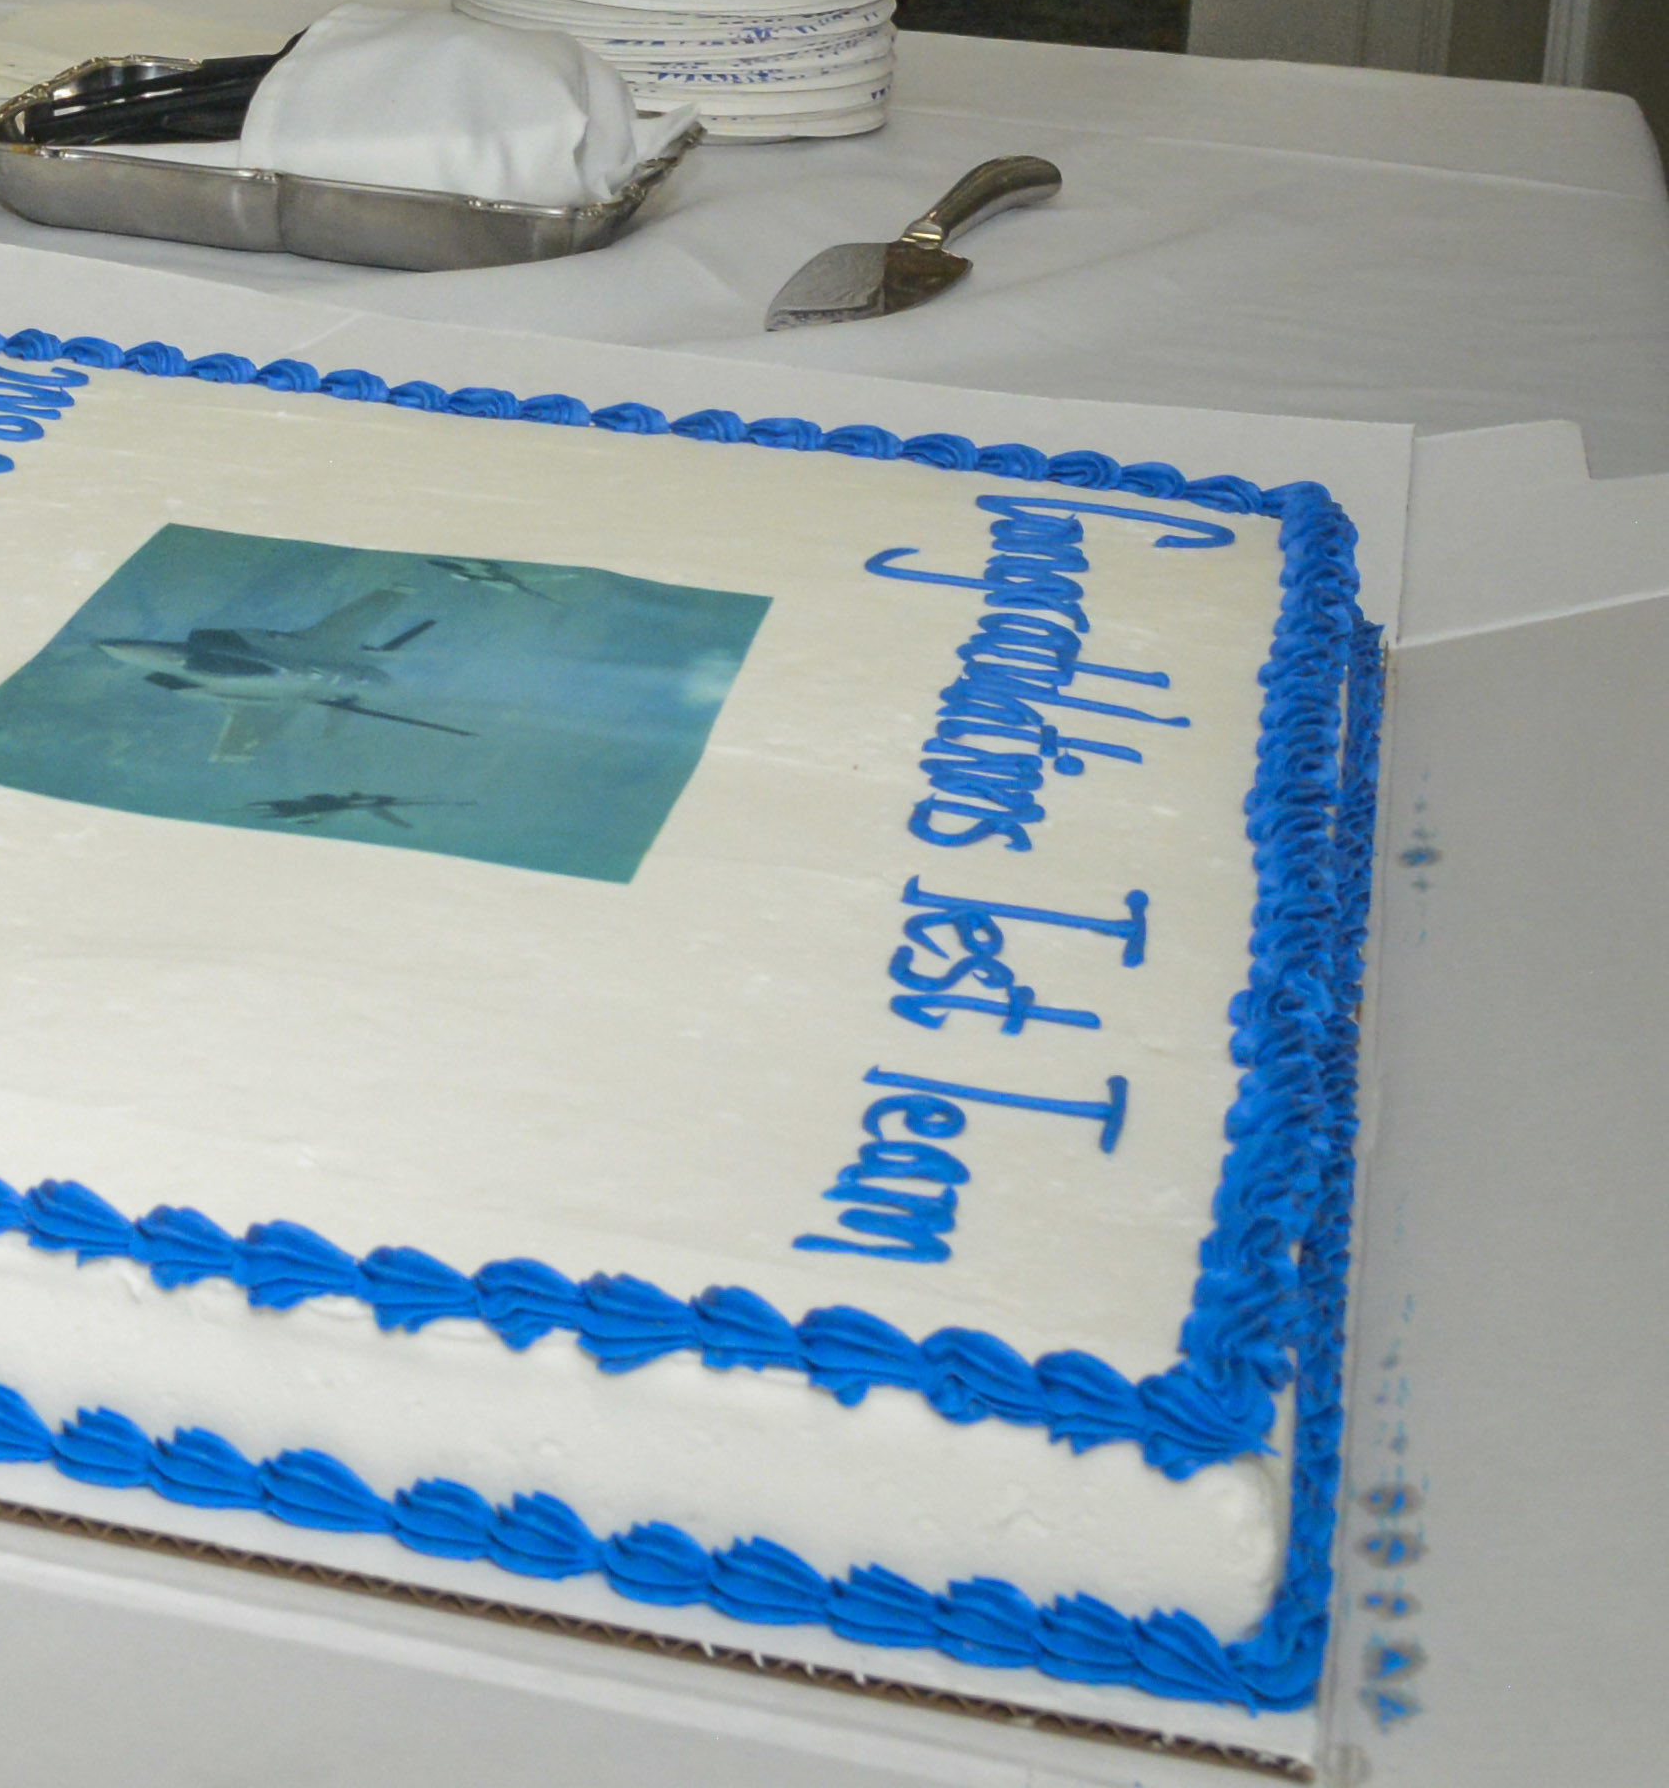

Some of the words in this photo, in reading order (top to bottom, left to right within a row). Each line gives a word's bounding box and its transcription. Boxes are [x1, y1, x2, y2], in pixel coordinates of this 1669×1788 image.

[866, 495, 1236, 853] Congratulations
[889, 874, 1150, 1037] Test
[793, 1067, 1128, 1264] Team
